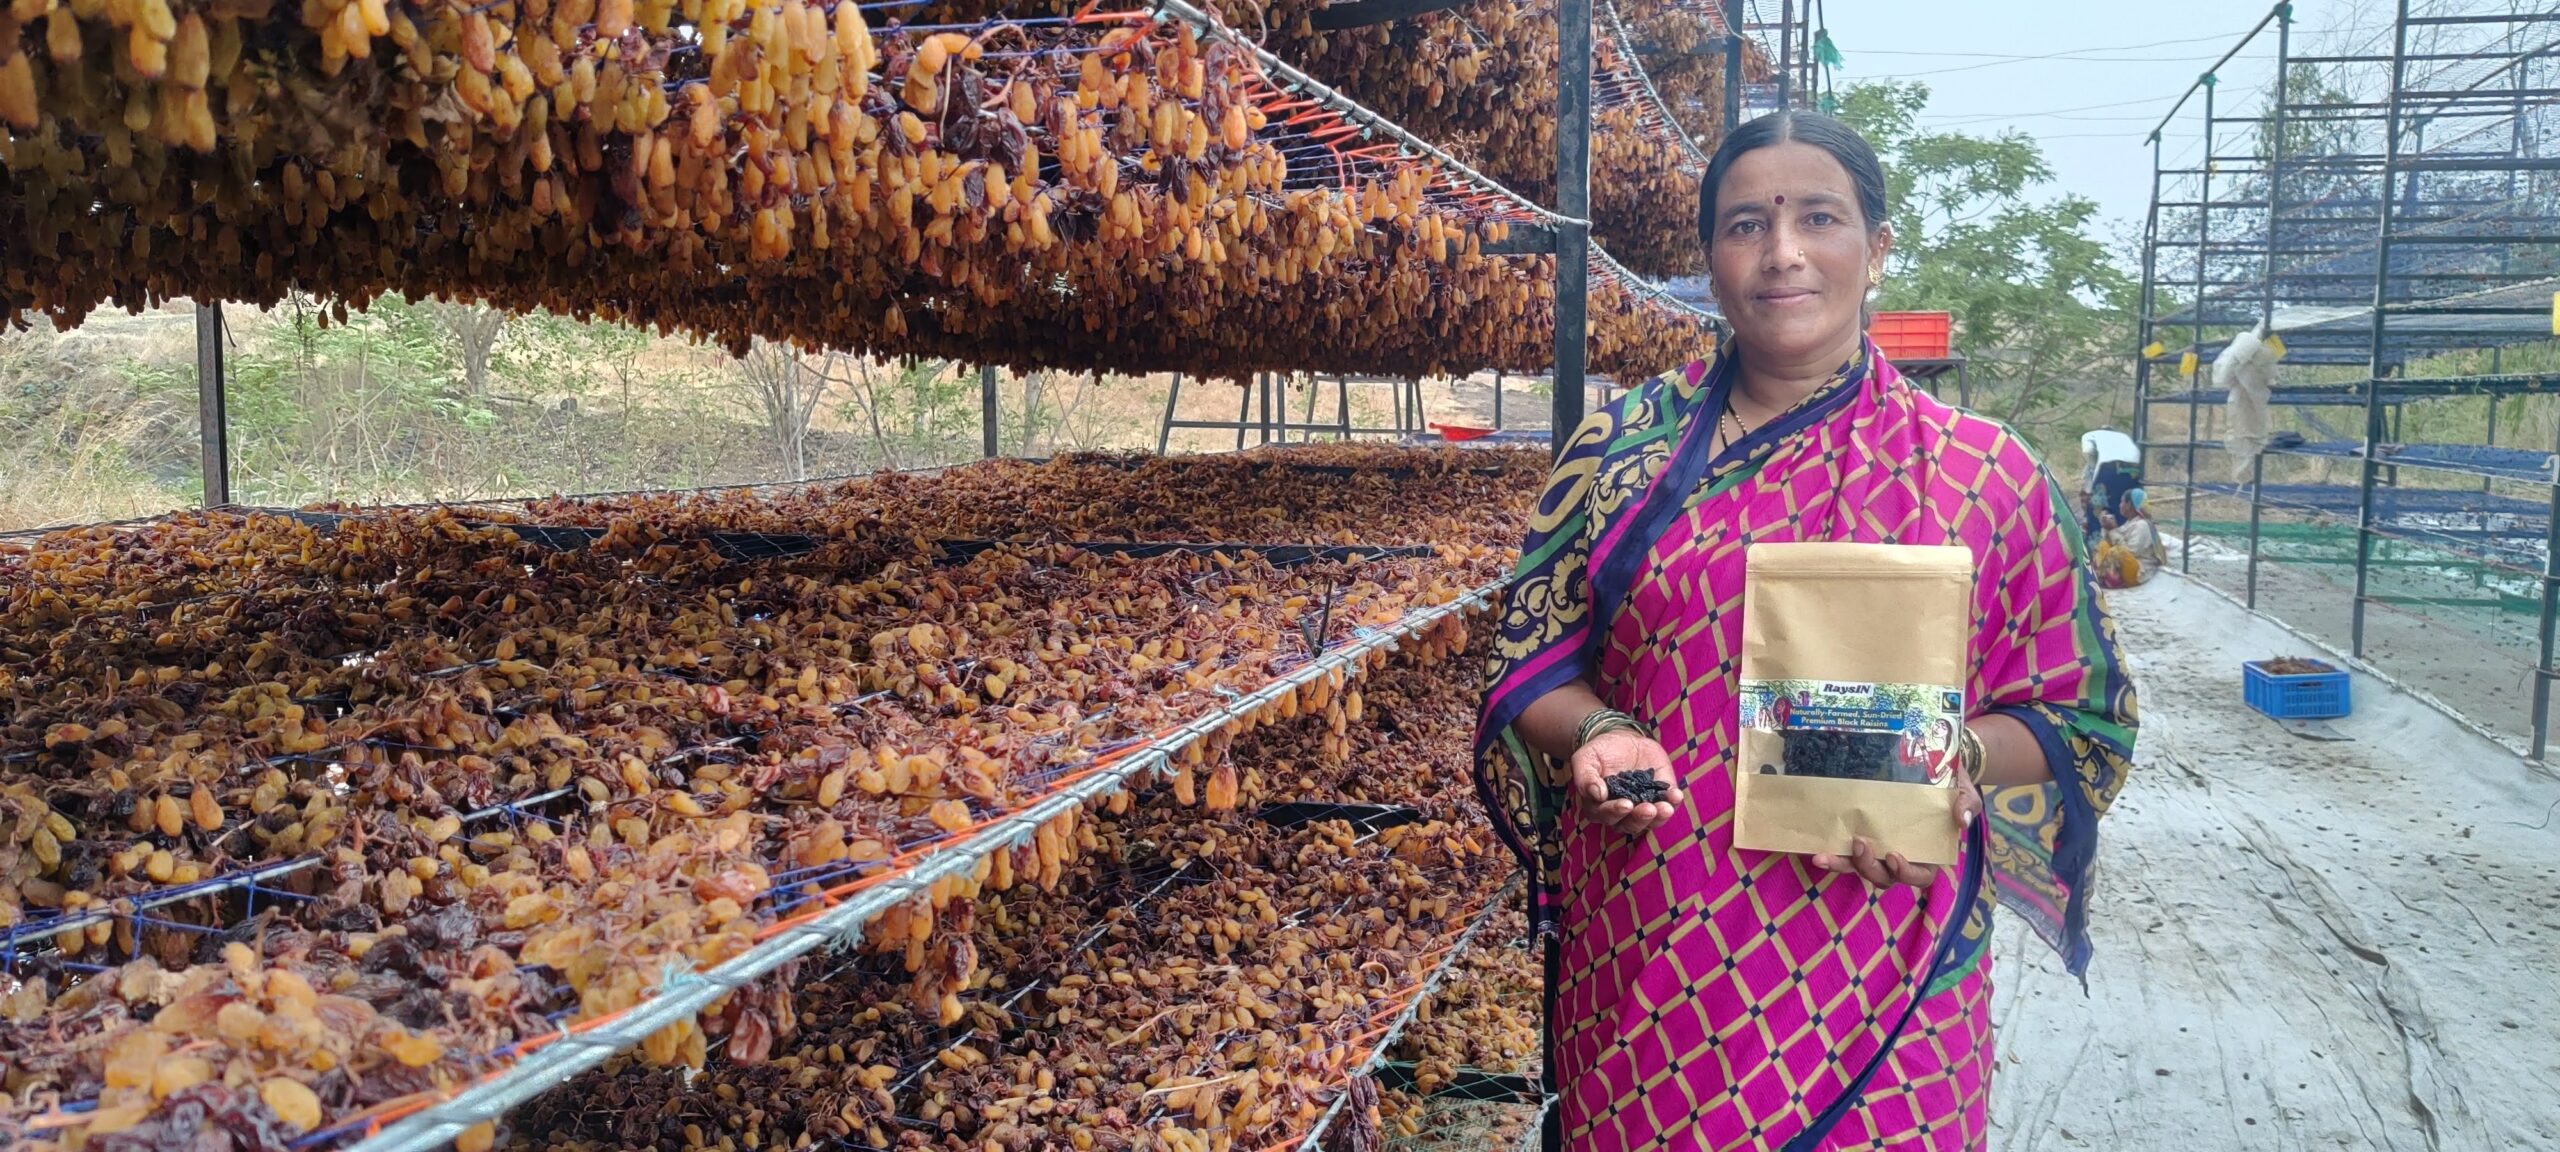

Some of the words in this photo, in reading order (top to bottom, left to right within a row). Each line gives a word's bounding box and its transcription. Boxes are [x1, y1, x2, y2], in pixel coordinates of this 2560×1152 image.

[1823, 683, 1871, 694] RaysIN
[1862, 711, 1902, 720] Sun-Dried
[1801, 716, 1835, 725] Premium
[1837, 718, 1859, 726] Black
[1860, 719, 1888, 727] Raisins
